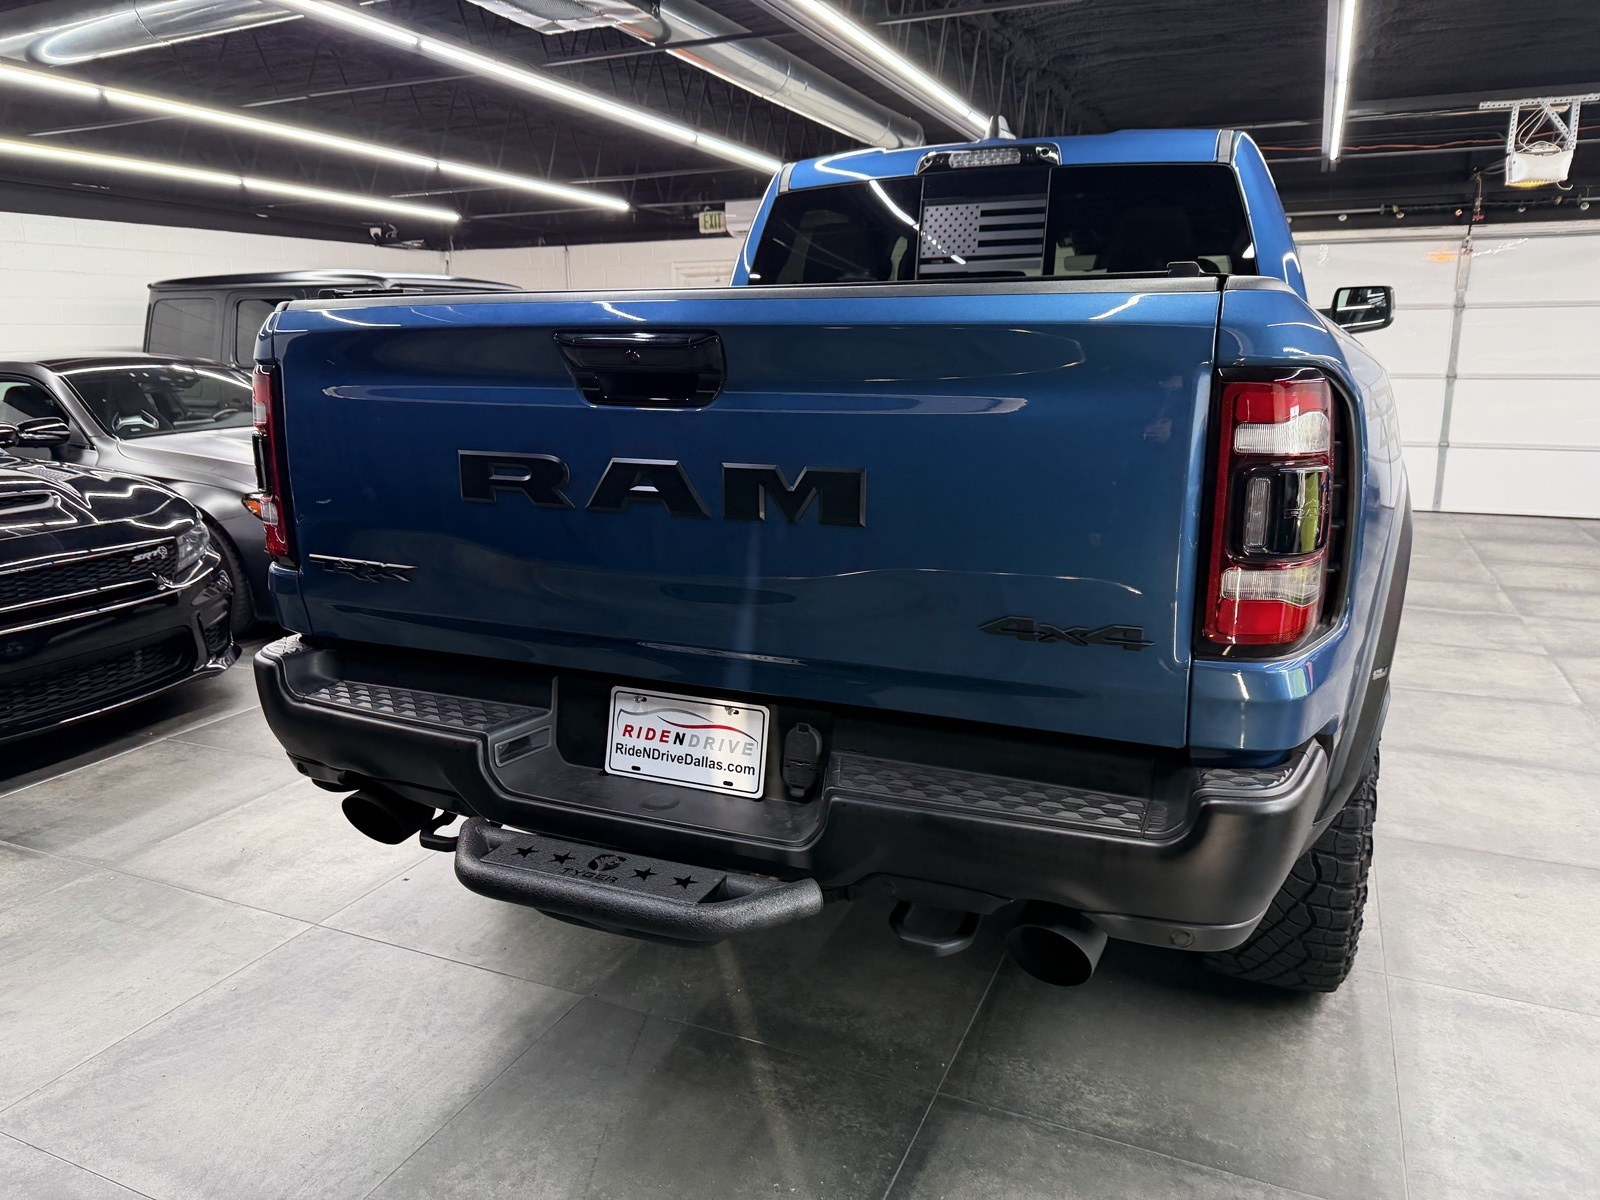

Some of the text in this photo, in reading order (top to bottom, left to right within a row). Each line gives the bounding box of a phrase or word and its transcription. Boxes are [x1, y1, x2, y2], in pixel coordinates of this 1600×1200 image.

[703, 212, 722, 230] EXIT
[457, 449, 868, 528] RAM
[614, 742, 756, 776] RideNDriveDallas.com
[562, 867, 619, 883] TYGER
